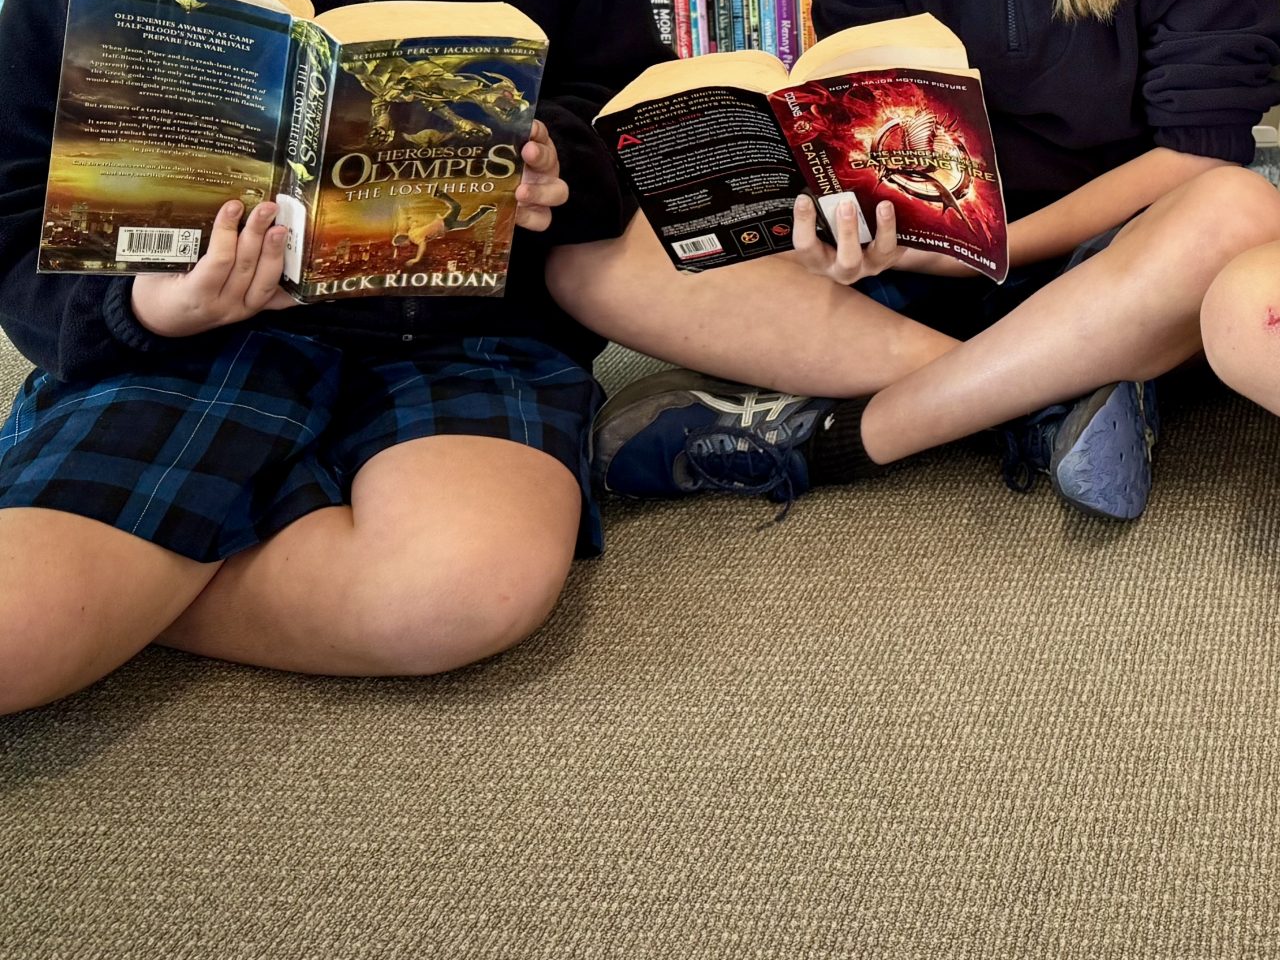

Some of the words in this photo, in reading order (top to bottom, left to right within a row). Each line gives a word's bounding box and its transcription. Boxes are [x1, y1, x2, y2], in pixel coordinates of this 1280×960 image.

[114, 12, 134, 21] OLD
[137, 16, 176, 28] ENEMIES
[178, 23, 214, 35] AWAKEN
[230, 34, 255, 44] CAMP
[780, 20, 791, 53] Kenny
[142, 33, 182, 45] PREPARE
[184, 40, 202, 48] FOR
[186, 32, 208, 42] NEW
[209, 37, 251, 52] ARRIVALS
[353, 51, 388, 60] RETURN
[407, 47, 440, 55] PERCY
[444, 46, 500, 55] JACKSON'S
[503, 48, 535, 56] WORLD
[861, 78, 893, 86] MAJOR
[931, 81, 967, 91] PICTURE
[377, 147, 455, 162] HEROES
[457, 146, 483, 158] OF
[850, 159, 952, 170] CATCHING
[331, 144, 517, 189] OLYMPUS
[801, 142, 833, 194] CATCHIN
[345, 189, 381, 202] THE
[390, 183, 439, 196] LOST
[444, 181, 494, 193] HERO
[954, 245, 997, 270] COLLINS
[316, 275, 375, 296] RICK
[385, 271, 498, 288] RIORDAN
